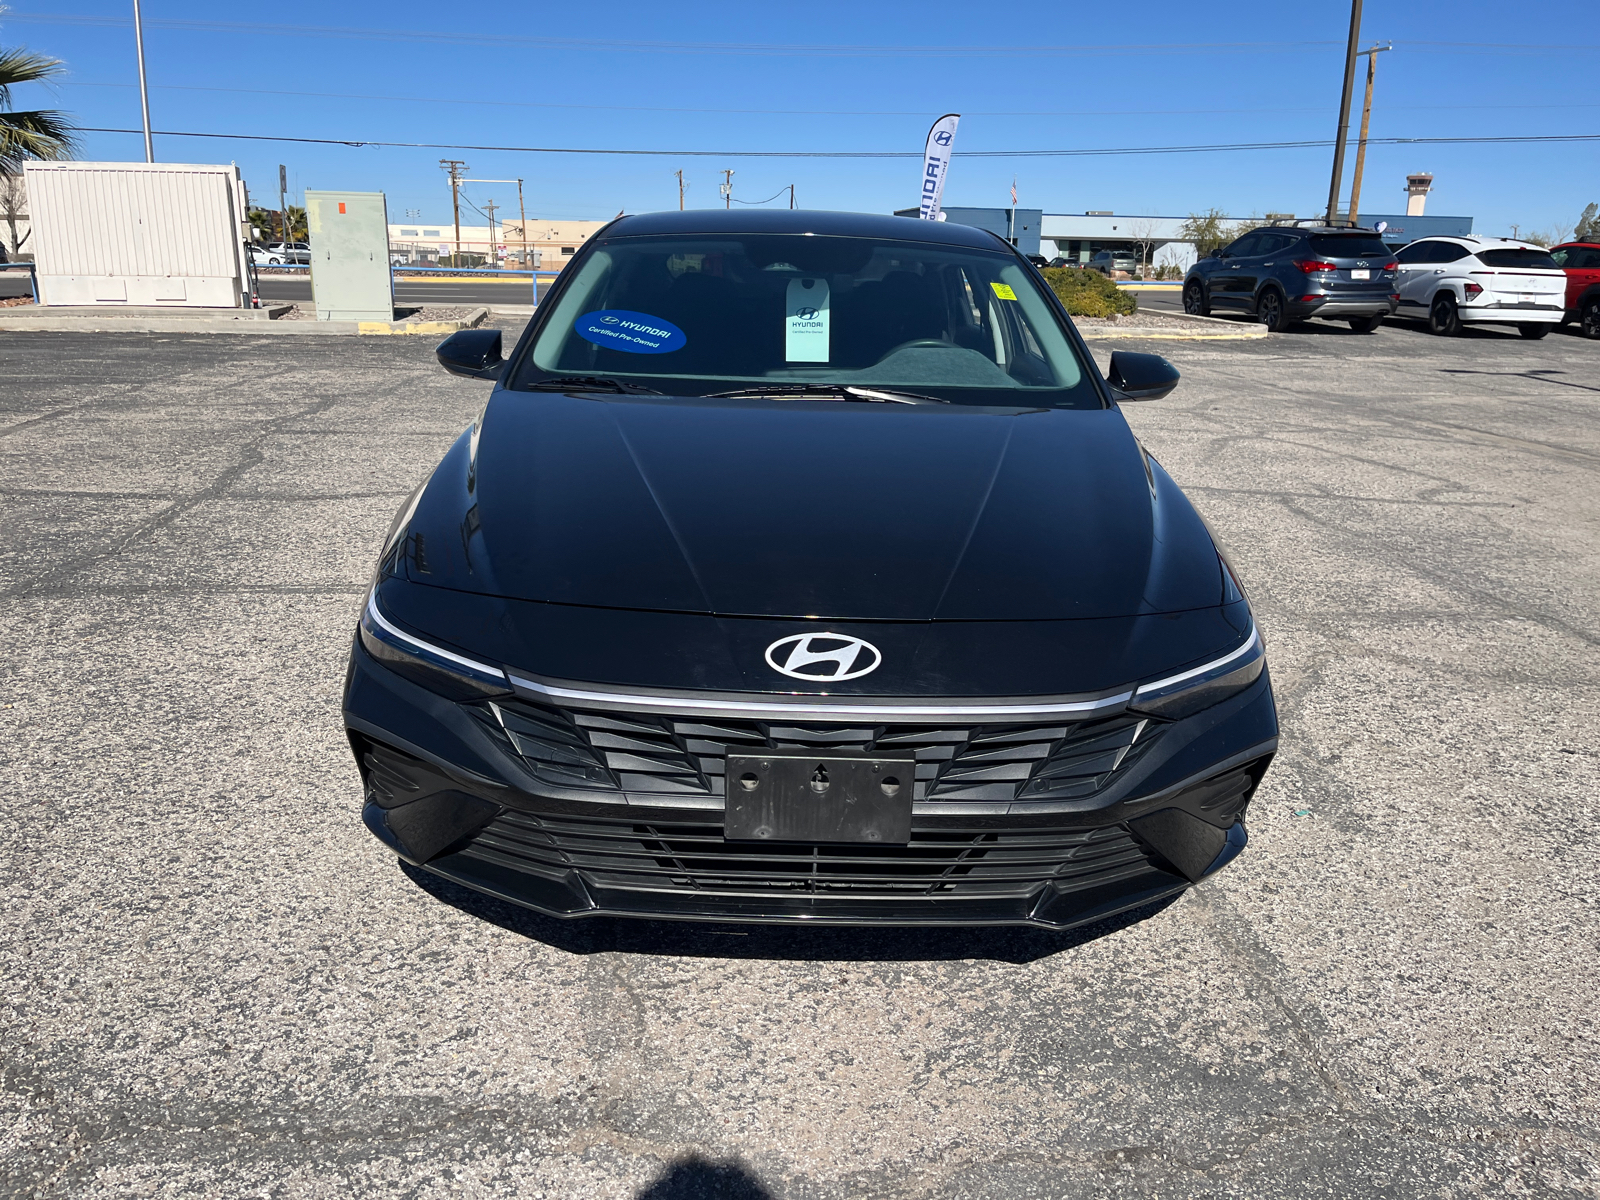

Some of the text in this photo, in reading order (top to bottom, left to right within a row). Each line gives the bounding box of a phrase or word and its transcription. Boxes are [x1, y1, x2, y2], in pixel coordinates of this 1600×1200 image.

[920, 156, 941, 219] UNDAI
[588, 326, 660, 348] Certified Pre-Owned
[620, 320, 671, 339] HYUNDAI
